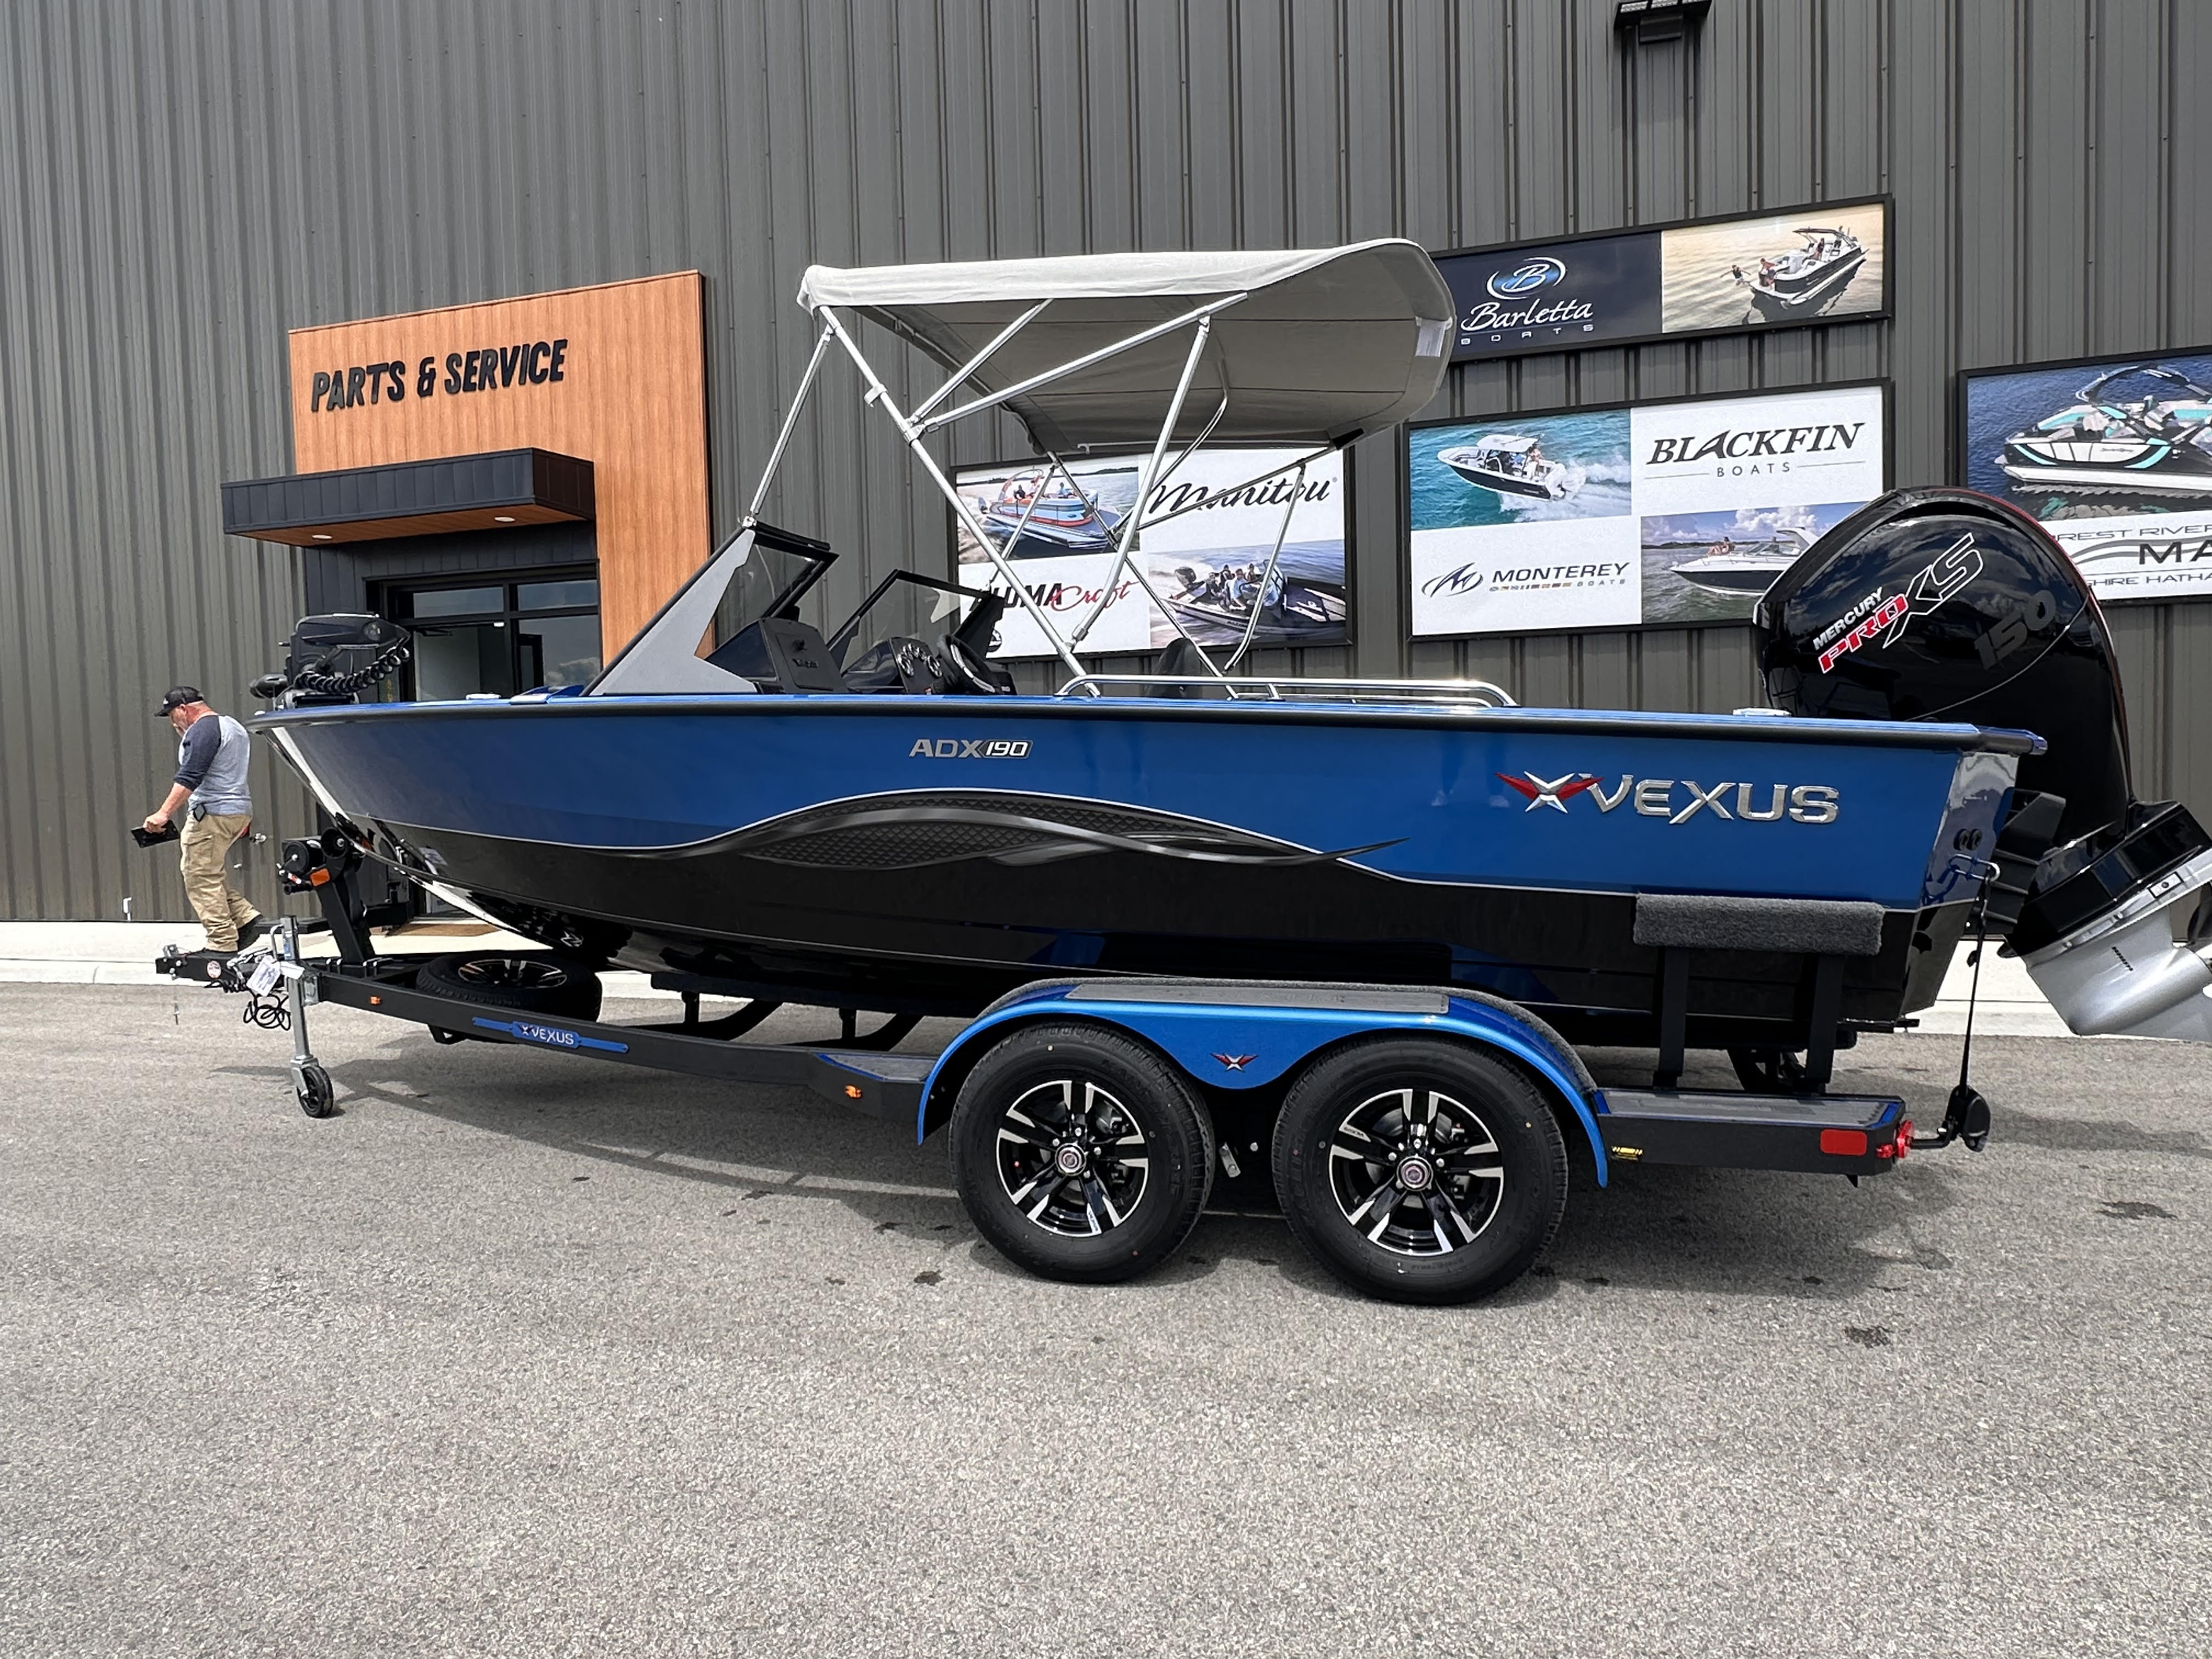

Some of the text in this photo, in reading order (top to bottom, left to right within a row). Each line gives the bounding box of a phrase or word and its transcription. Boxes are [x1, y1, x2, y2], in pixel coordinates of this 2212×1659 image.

[1460, 298, 1593, 331] Barletta
[1460, 324, 1594, 345] BOATS
[311, 338, 568, 412] PARTS & SERVICE
[1646, 422, 1865, 465] BLACKFIN
[1717, 462, 1791, 477] BOATS
[2053, 529, 2133, 541] REST
[1492, 562, 1630, 583] MONTEREY
[1576, 579, 1626, 588] BOATS
[1813, 586, 1883, 651] MERCURY
[1818, 593, 1909, 674] PRO
[1974, 589, 2057, 671] 150
[1578, 774, 1839, 824] VEXUS
[531, 1026, 574, 1045] VEXUS
